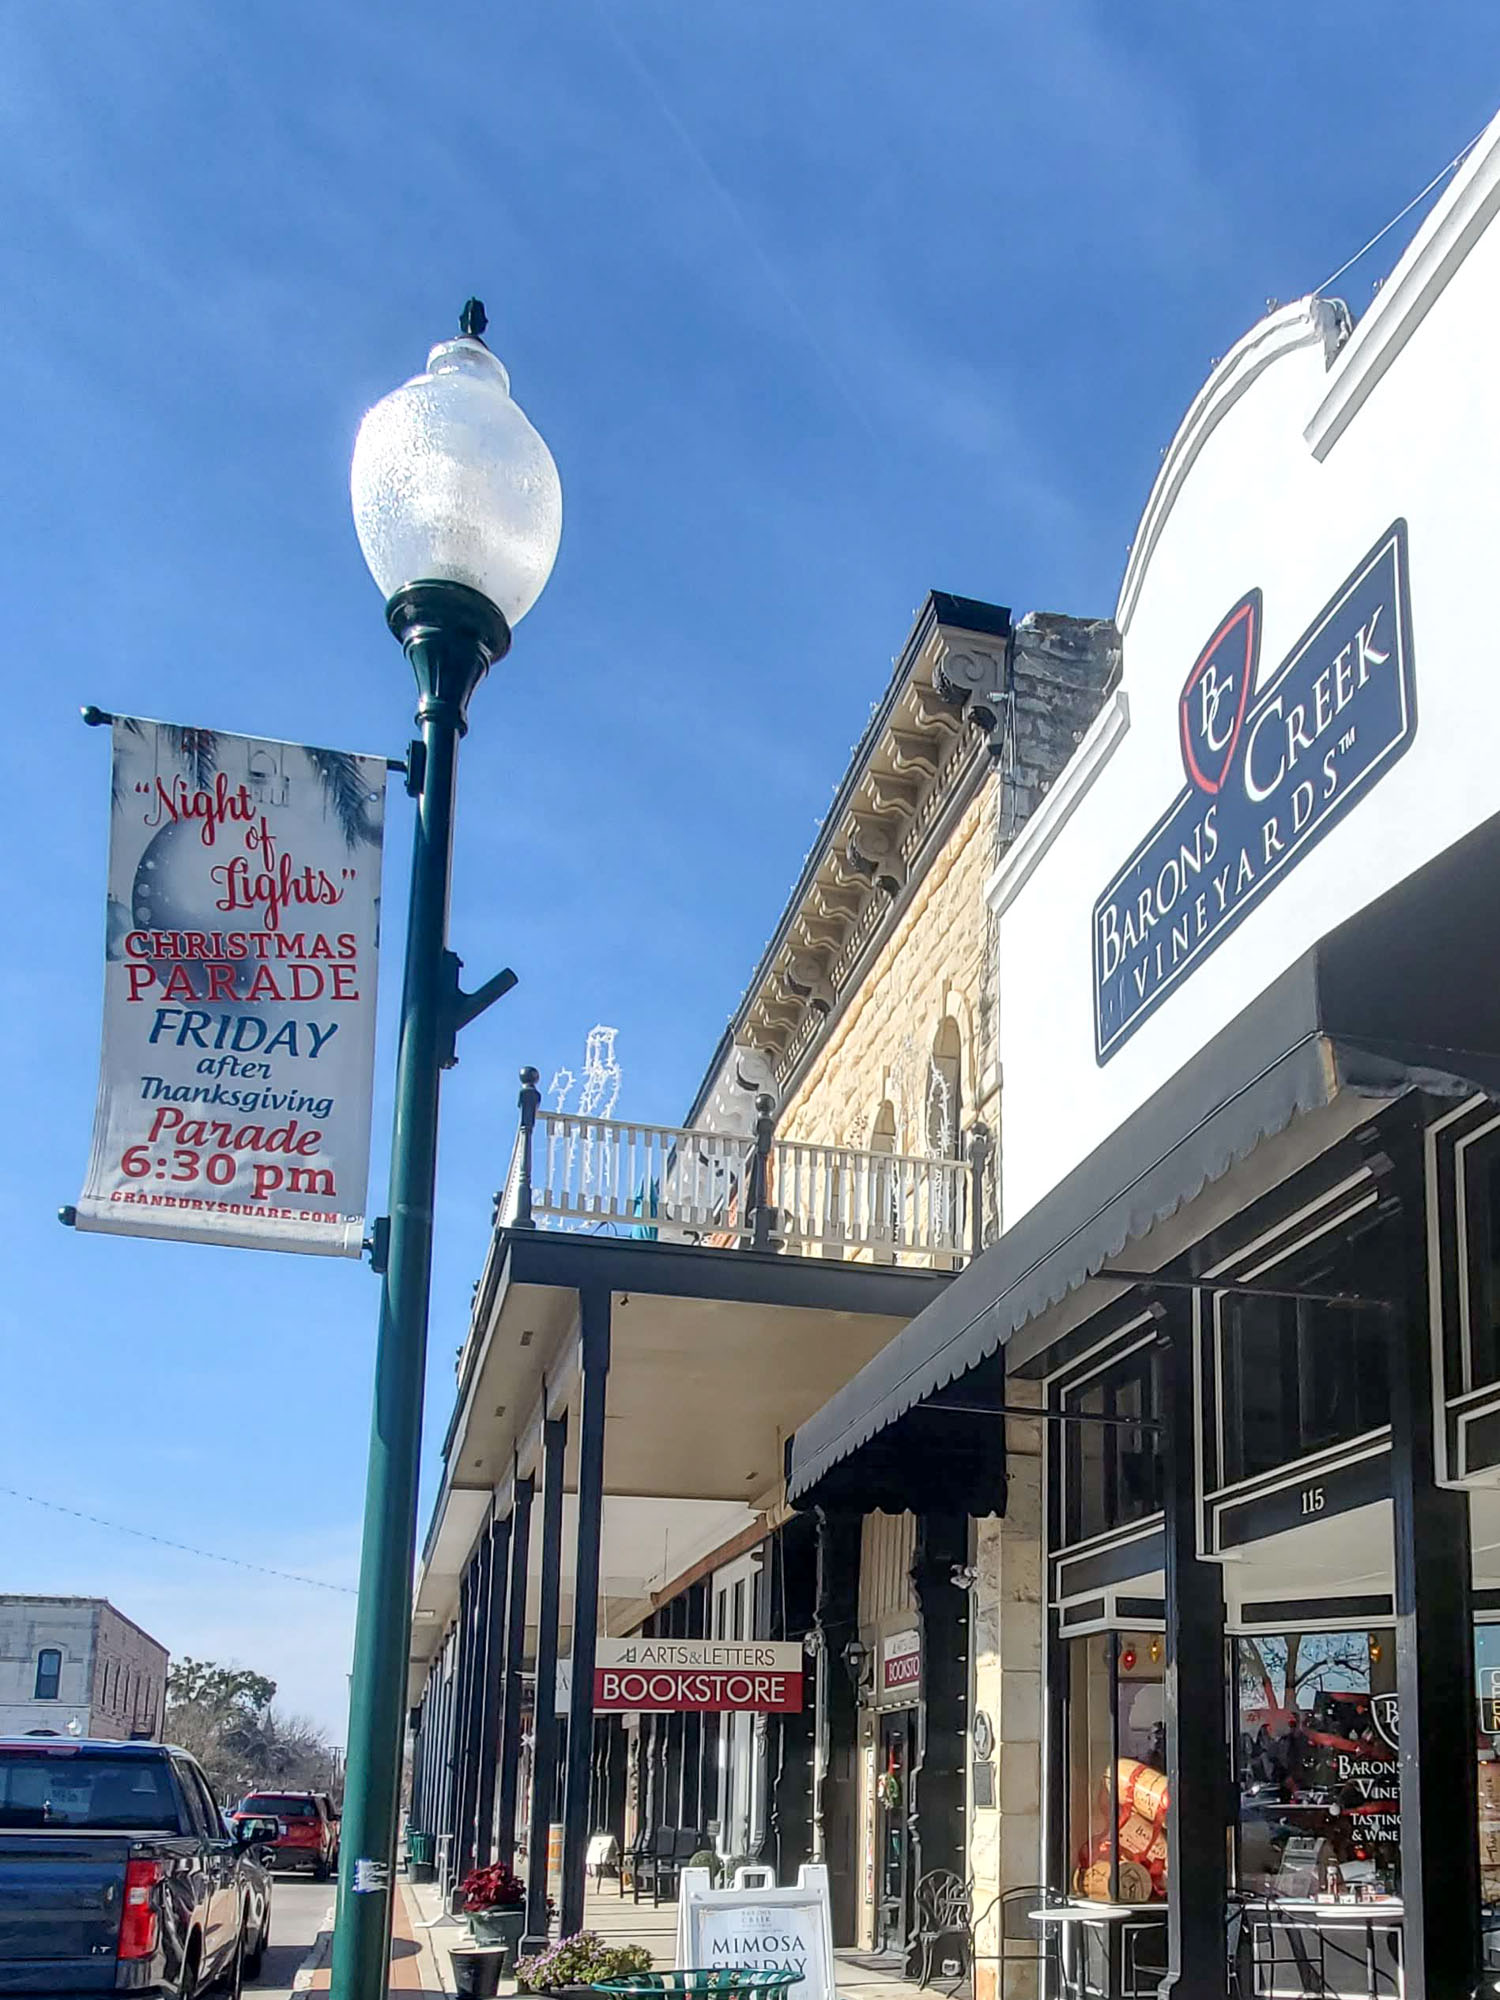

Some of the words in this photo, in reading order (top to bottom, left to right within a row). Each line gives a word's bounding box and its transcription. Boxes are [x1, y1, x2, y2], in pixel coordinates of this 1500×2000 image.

[1100, 804, 1219, 986] BARONS
[1244, 604, 1390, 802] CREEK
[245, 815, 278, 872] of
[124, 931, 358, 961] CHRISTMAS
[125, 963, 361, 1002] PARADE
[148, 1008, 339, 1059] FRIDAY
[196, 1055, 273, 1081] after
[140, 1076, 335, 1119] Thanksgiving
[147, 1106, 324, 1157] Parade
[119, 1145, 238, 1186] 6:30
[249, 1162, 337, 1200] pm
[110, 1191, 339, 1225] GRANBURYSQUARE.COM
[1301, 1487, 1325, 1516] 115
[602, 1673, 786, 1704] BOOKSTORE
[1356, 1778, 1401, 1799] VINE
[1351, 1829, 1363, 1842] &
[1365, 1829, 1399, 1842] WINE
[711, 1934, 806, 1955] MIMOSA
